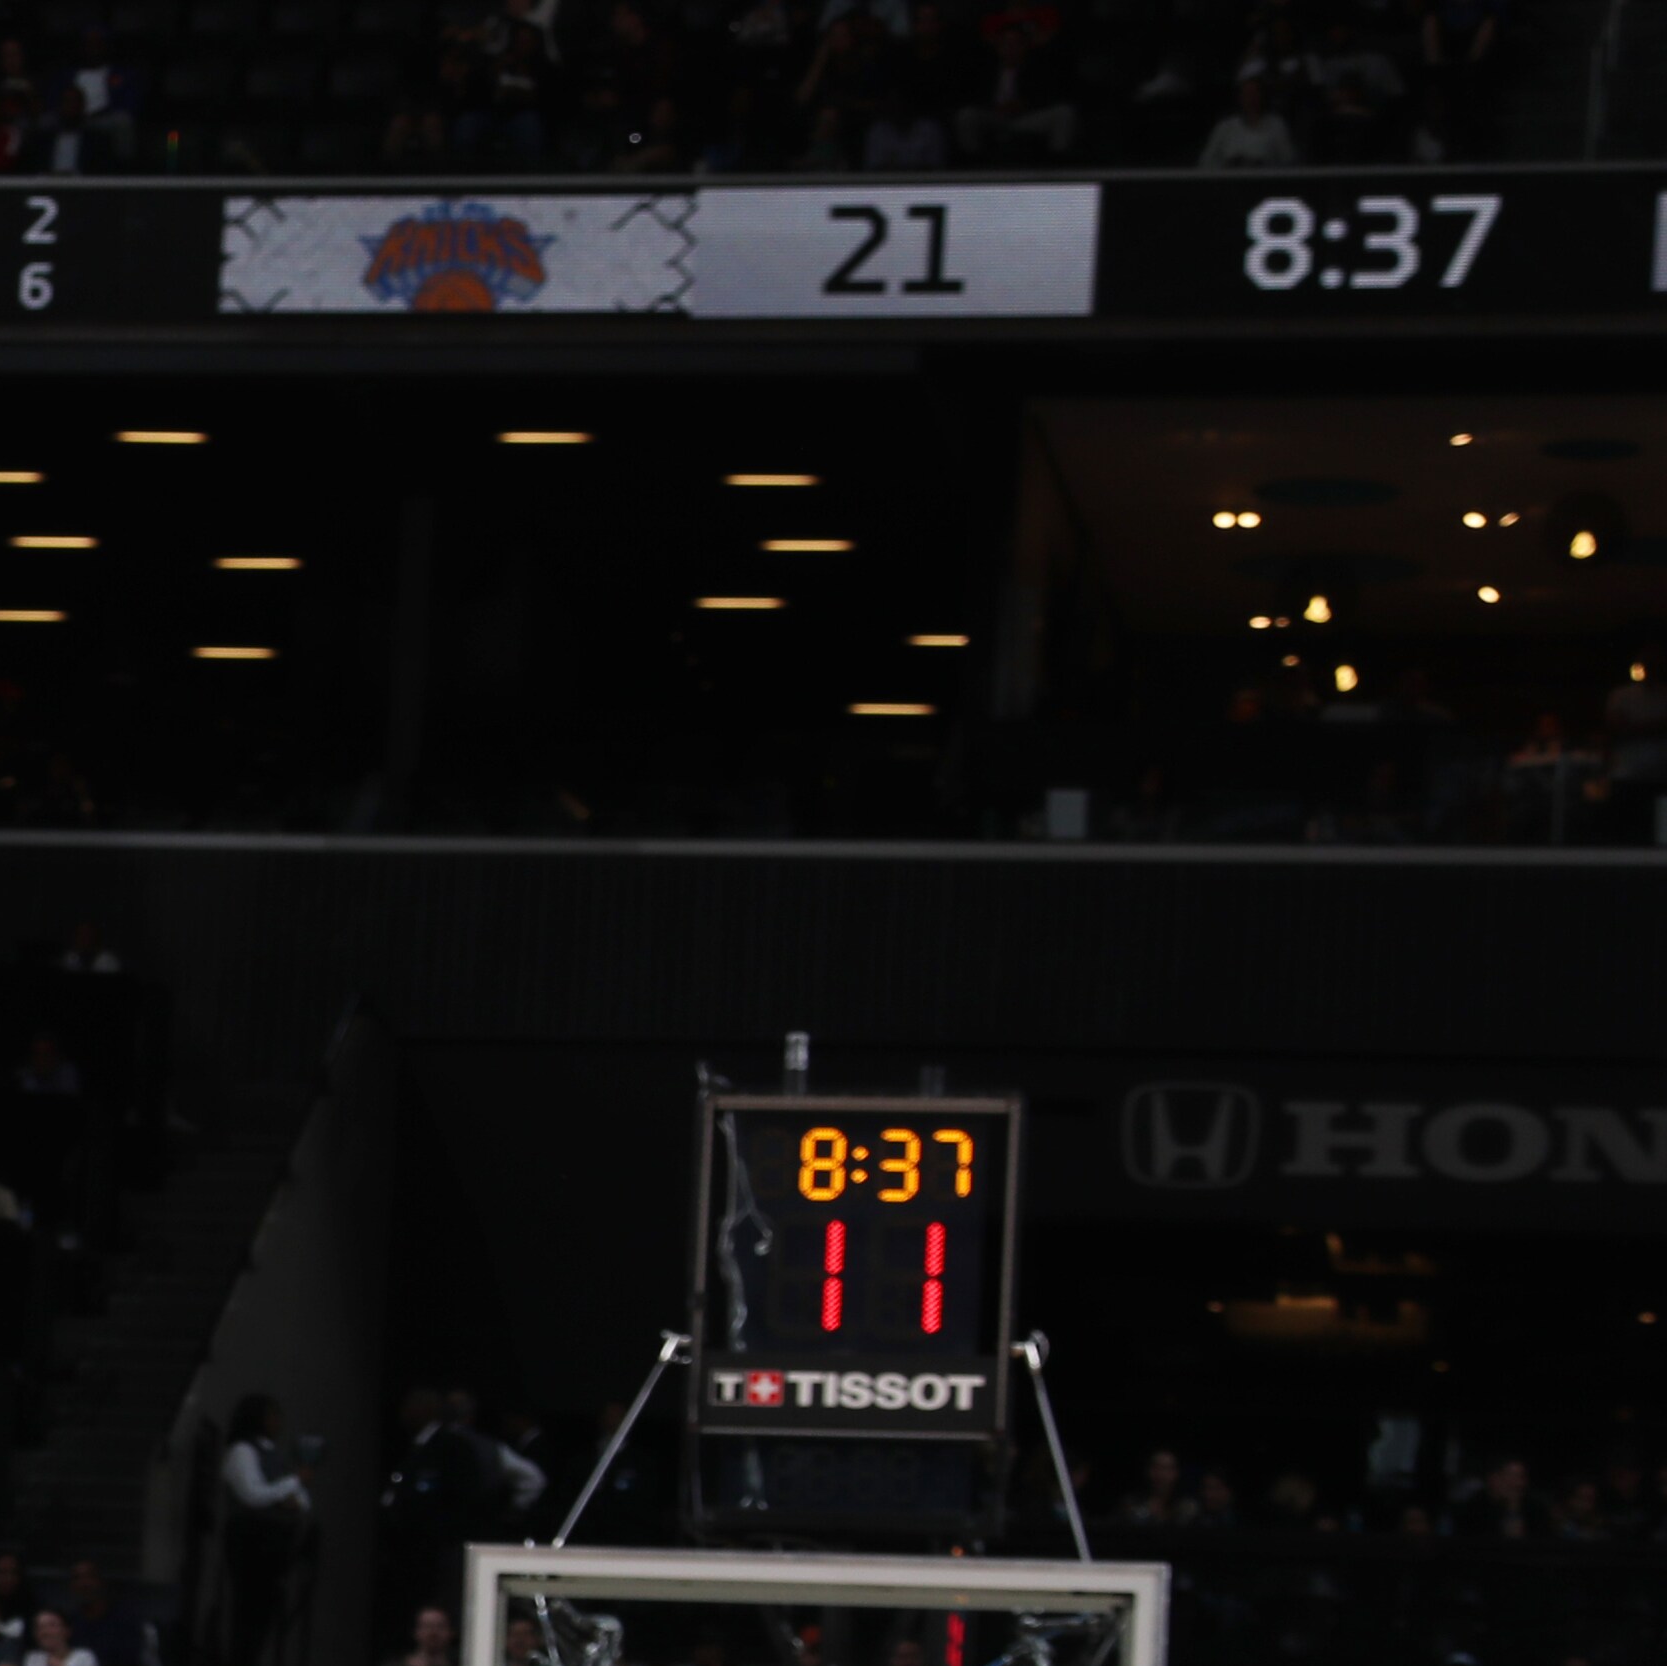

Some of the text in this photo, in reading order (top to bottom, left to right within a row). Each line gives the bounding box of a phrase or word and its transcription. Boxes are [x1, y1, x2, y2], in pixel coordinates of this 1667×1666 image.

[22, 195, 59, 244] 2
[822, 203, 965, 295] 21
[1243, 195, 1503, 290] 8:37
[19, 261, 55, 311] 6
[798, 1126, 975, 1203] 8:37
[1279, 1100, 1667, 1183] HON
[820, 1219, 947, 1335] 11
[787, 1372, 987, 1411] TISSOT
